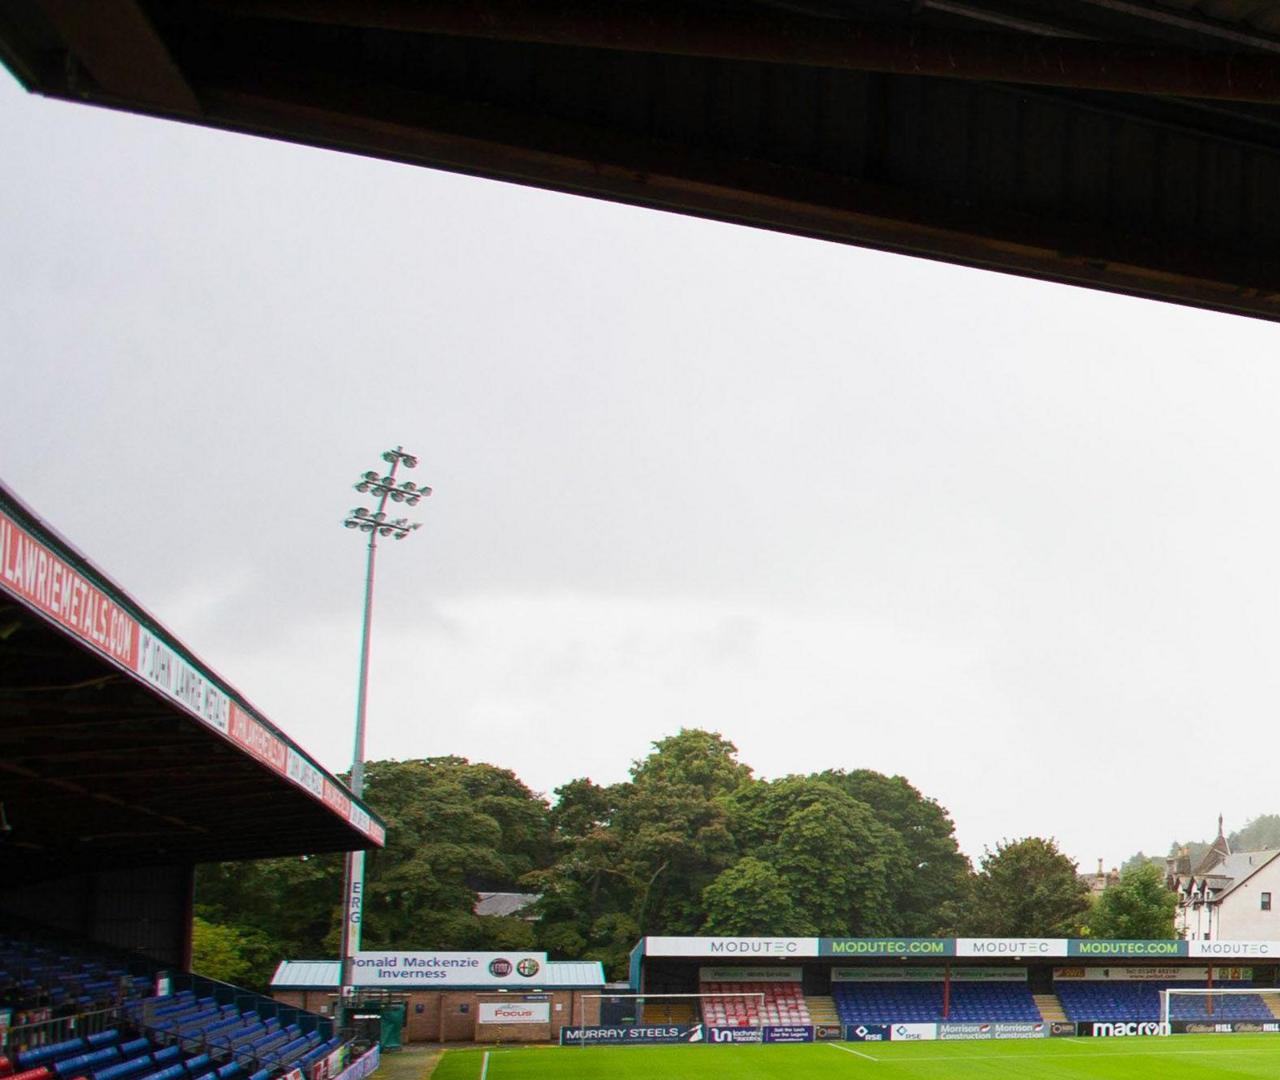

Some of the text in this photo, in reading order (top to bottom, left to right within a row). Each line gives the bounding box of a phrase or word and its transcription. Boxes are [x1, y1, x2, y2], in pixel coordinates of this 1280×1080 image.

[711, 942, 797, 952] MODUTEC
[832, 942, 944, 953] MODUTEC.COM
[973, 942, 1049, 953] MODUTEC
[1080, 942, 1178, 953] MODUTEC.COM
[403, 957, 479, 967] Mackenzie
[377, 968, 447, 978] Inverness
[494, 1009, 533, 1017] Focus
[940, 1025, 980, 1033] Morrison
[995, 1024, 1034, 1032] Morrison
[1092, 1022, 1171, 1036] macron
[1216, 1023, 1232, 1032] HILL
[1263, 1022, 1280, 1031] HILL
[566, 1027, 679, 1039] MURRAY STEELS
[940, 1032, 992, 1040] Construction
[995, 1032, 1044, 1040] Construction
